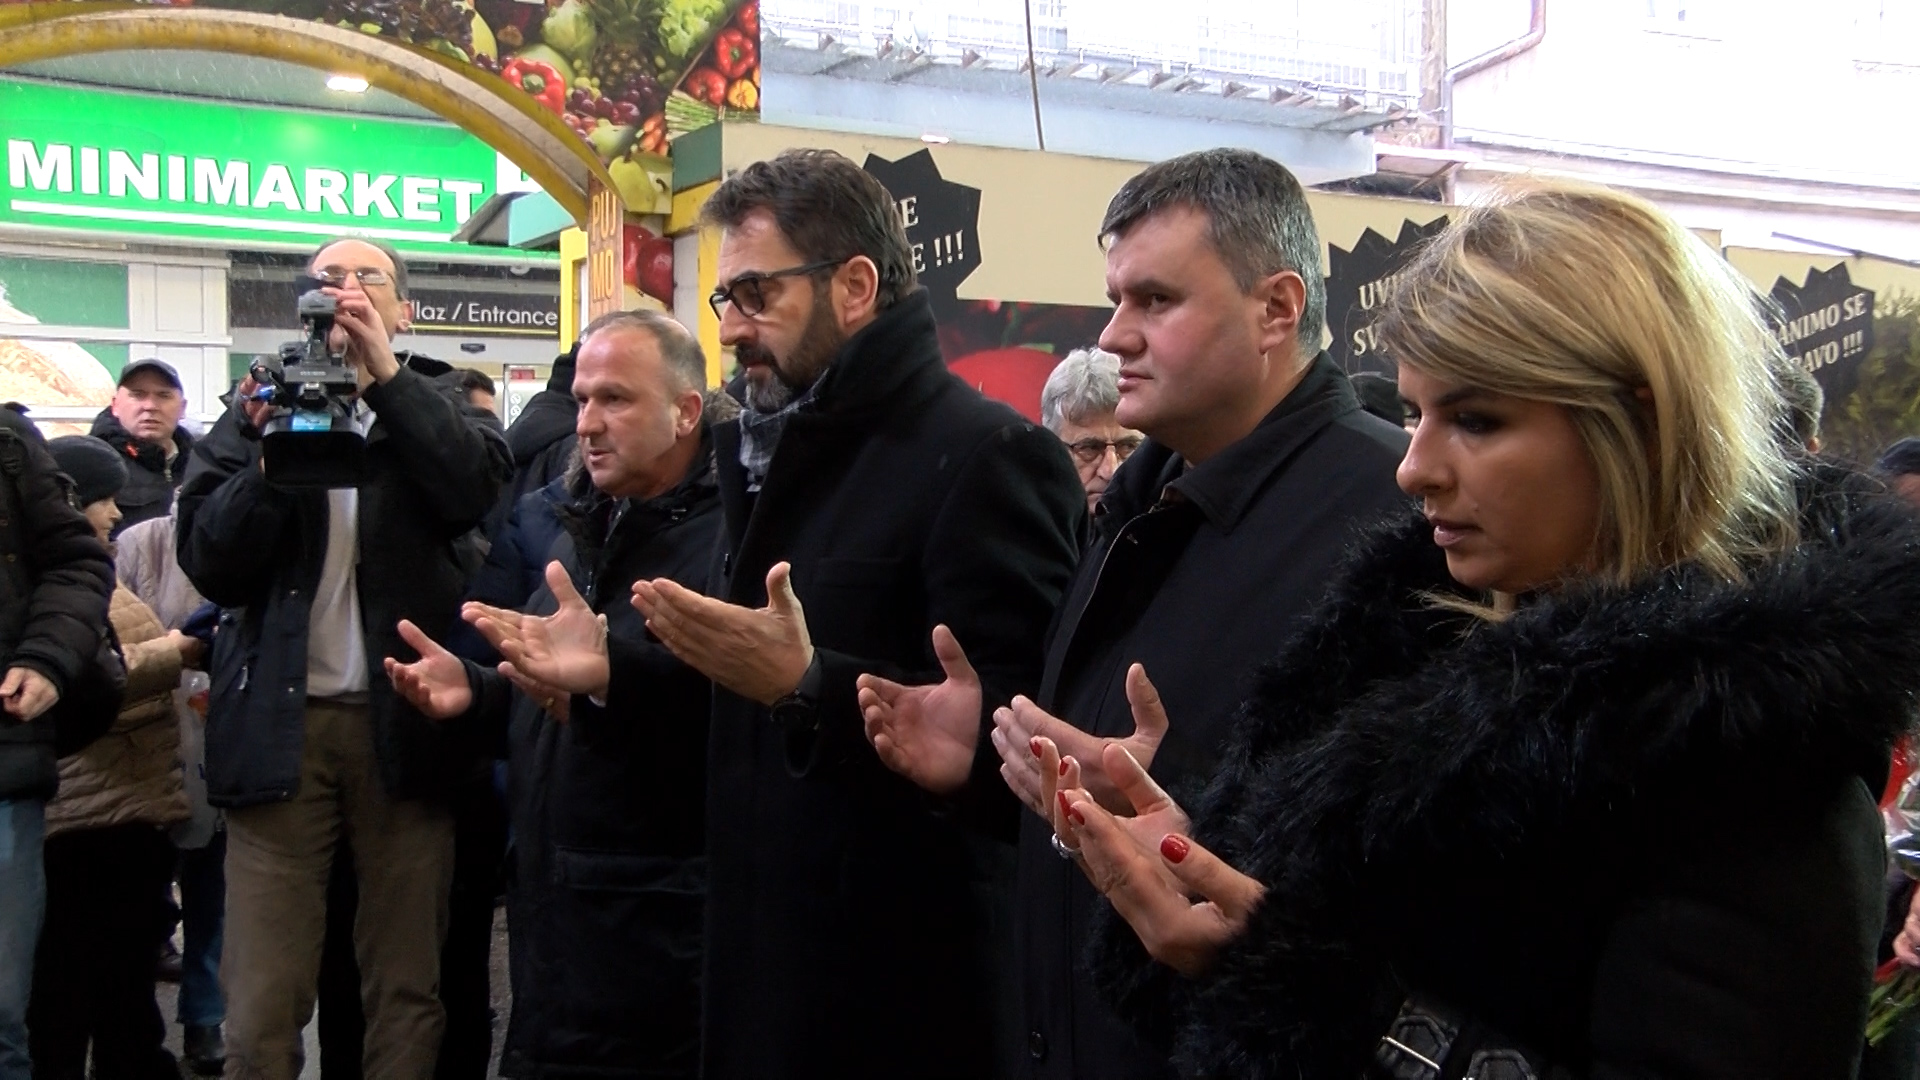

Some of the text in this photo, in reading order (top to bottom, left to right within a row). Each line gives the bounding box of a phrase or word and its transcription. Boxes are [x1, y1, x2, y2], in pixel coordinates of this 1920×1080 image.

[8, 139, 484, 224] MINIMARKET
[468, 303, 558, 326] Entrance
[1778, 293, 1867, 346] ANIMO SE
